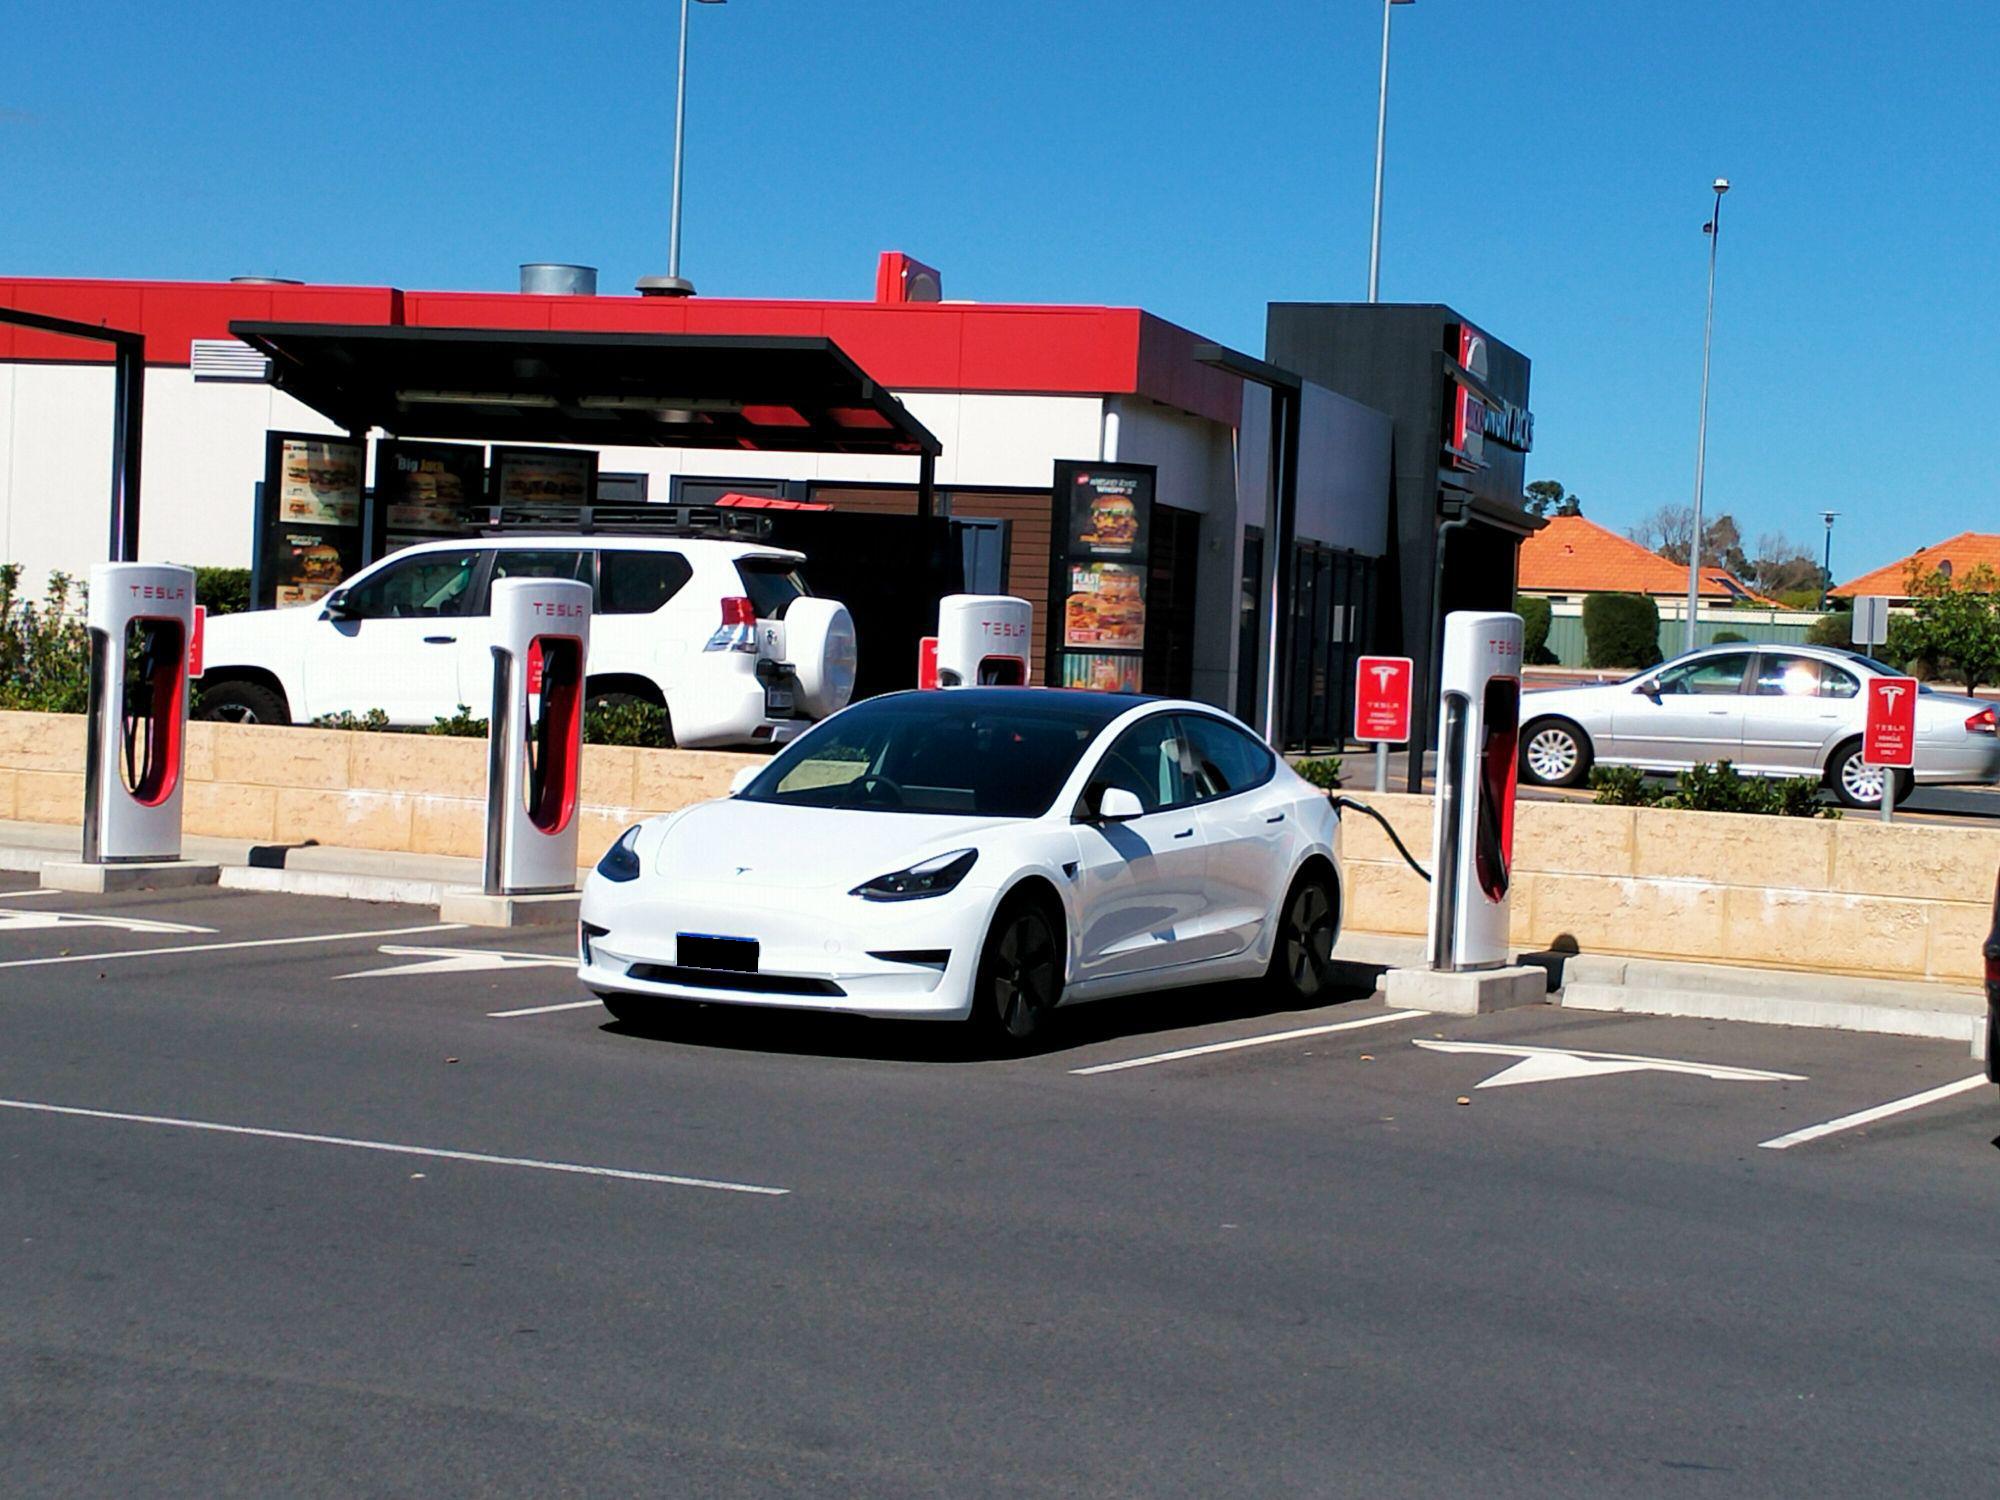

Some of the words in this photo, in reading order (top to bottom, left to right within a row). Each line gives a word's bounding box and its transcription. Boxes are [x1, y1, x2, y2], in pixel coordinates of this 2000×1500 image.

[1073, 572, 1100, 585] FEAST
[130, 586, 184, 599] TESLA
[533, 602, 583, 616] TESLA
[981, 622, 1025, 637] TESLA
[1366, 701, 1400, 709] TESLA
[1875, 723, 1905, 732] TESLA
